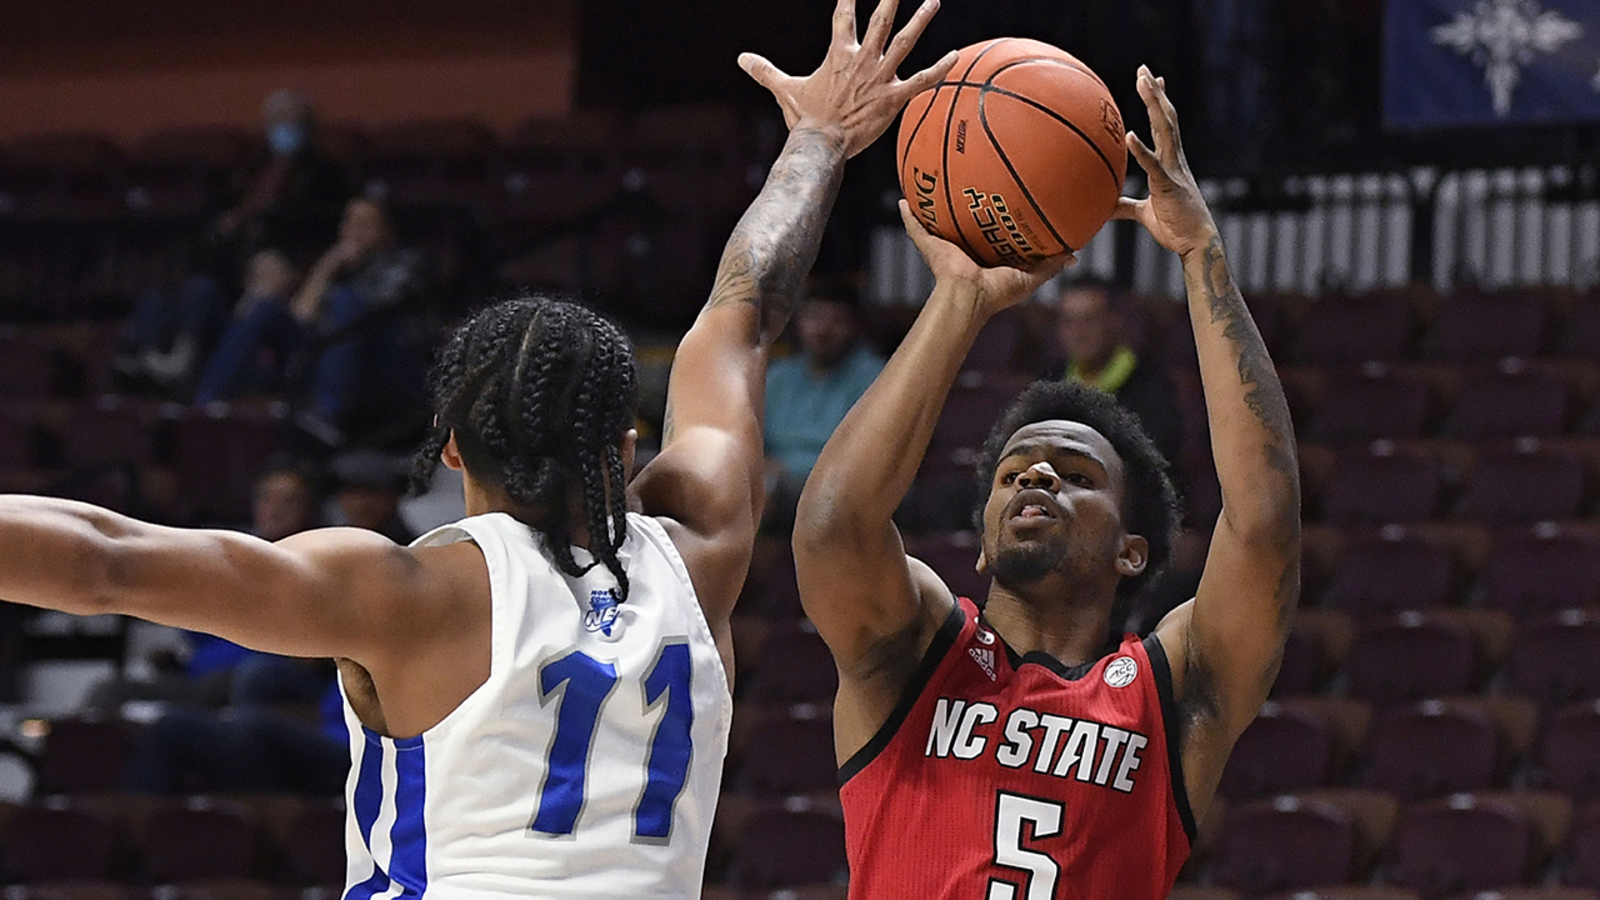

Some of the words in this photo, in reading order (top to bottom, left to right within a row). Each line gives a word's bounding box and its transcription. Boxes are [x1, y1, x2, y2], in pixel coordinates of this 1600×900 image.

[991, 194, 1033, 252] 1000
[969, 648, 997, 682] adidas
[525, 635, 694, 846] 11
[925, 698, 998, 759] NC
[996, 708, 1148, 793] STATE
[988, 792, 1062, 900] 5
